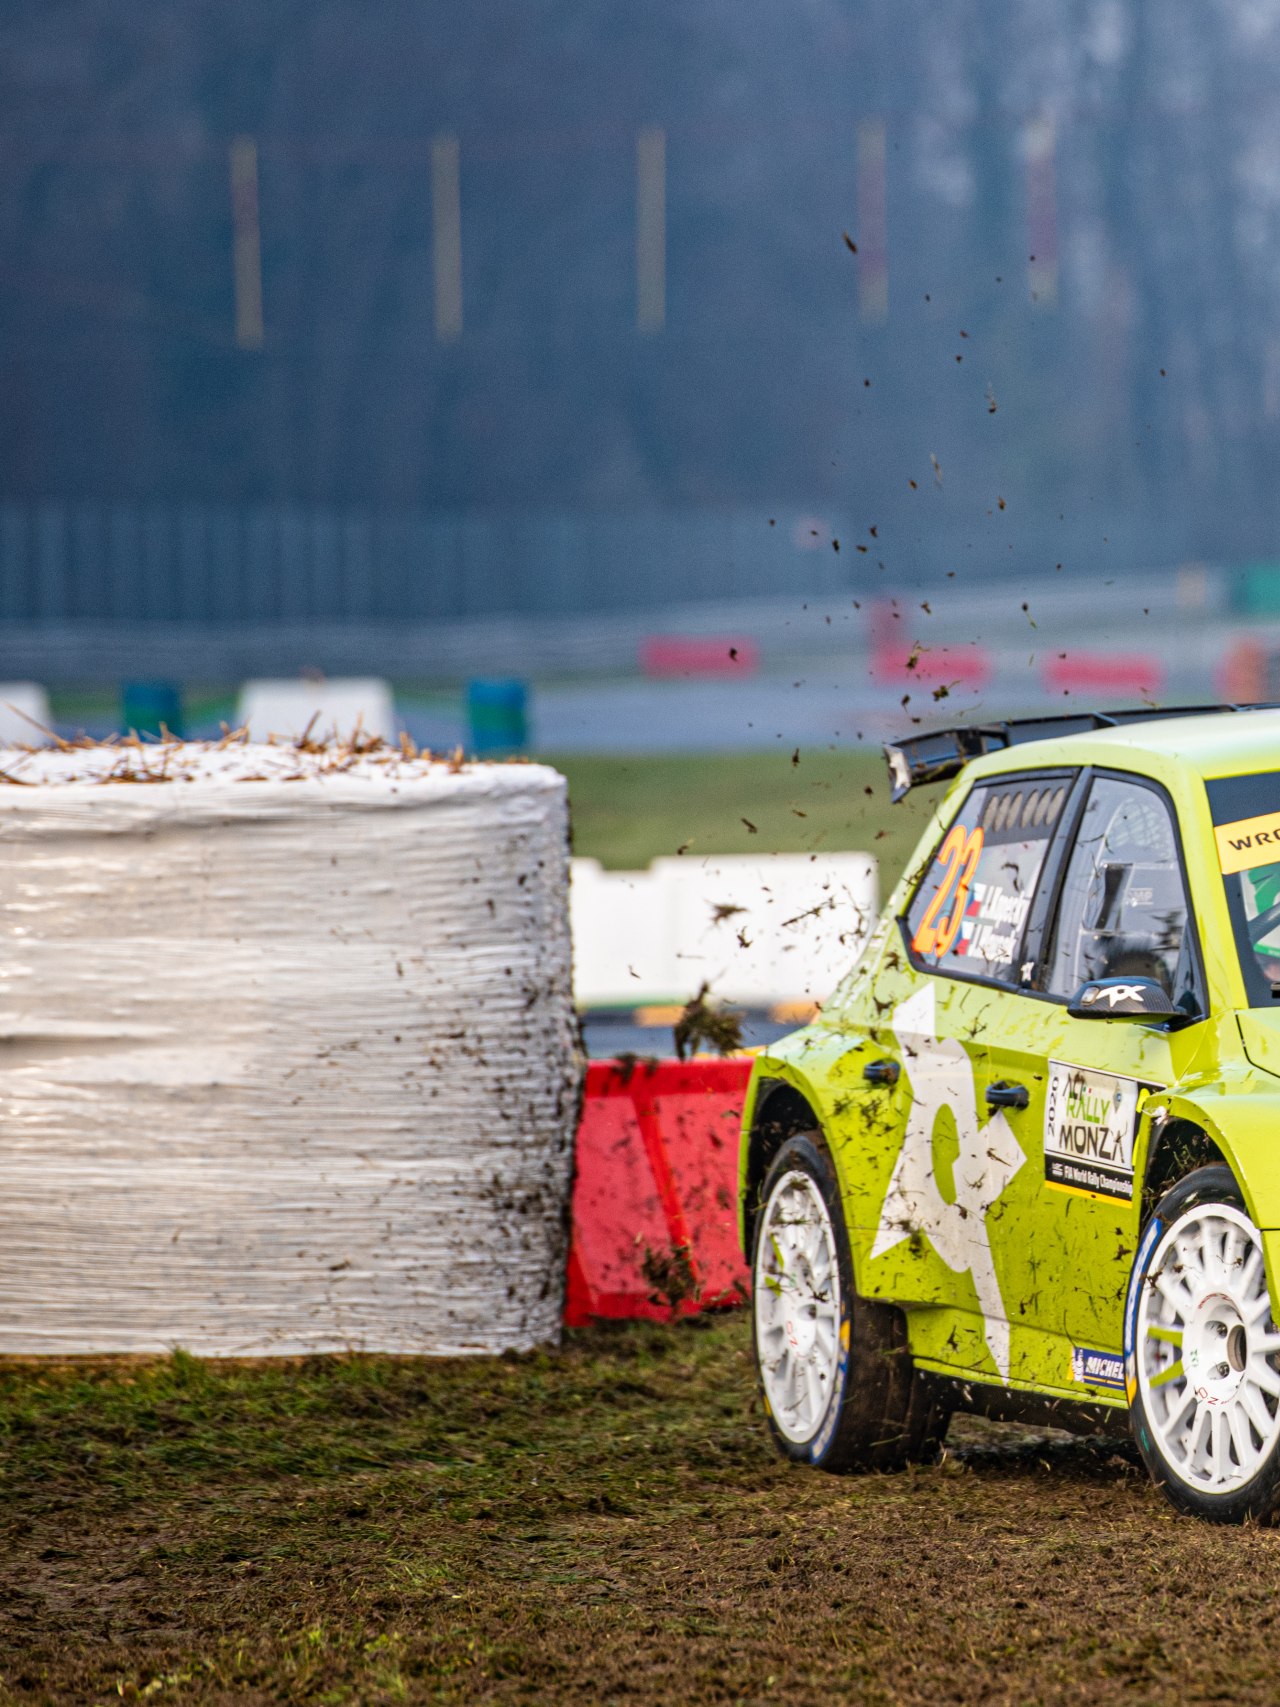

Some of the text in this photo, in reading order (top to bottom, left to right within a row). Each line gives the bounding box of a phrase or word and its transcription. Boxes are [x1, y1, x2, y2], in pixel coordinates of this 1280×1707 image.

[911, 825, 985, 959] 23
[1066, 1093, 1112, 1126] RALLY
[1058, 1124, 1126, 1165] MONZA
[1085, 1356, 1124, 1381] MICHEL
